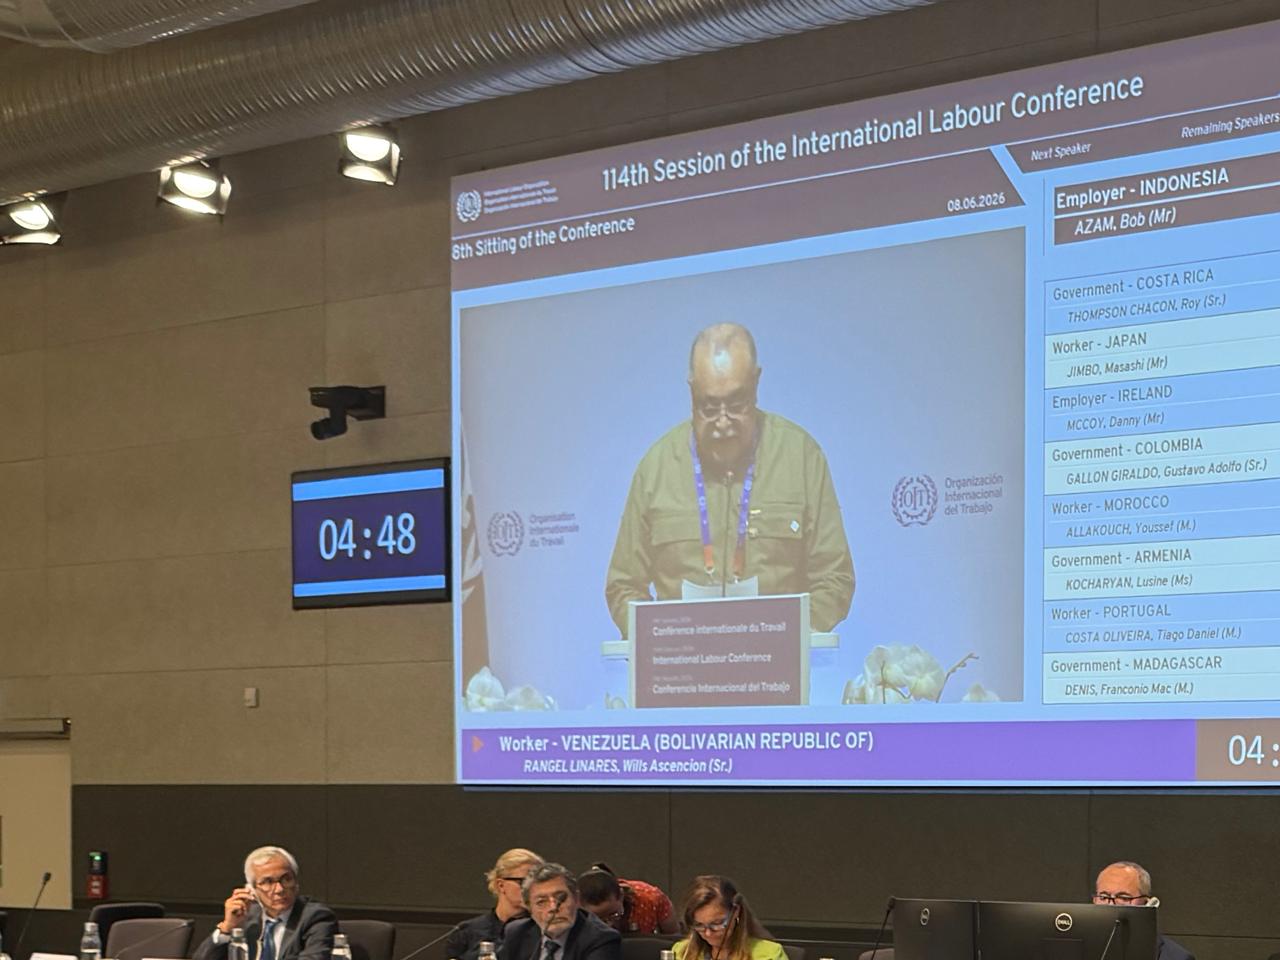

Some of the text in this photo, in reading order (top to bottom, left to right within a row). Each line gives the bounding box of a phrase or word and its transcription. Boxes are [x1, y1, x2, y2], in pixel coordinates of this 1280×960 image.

[602, 70, 1144, 193] 114th Session of the International Labour Conference
[1180, 107, 1280, 141] Remaining Speakers
[1030, 138, 1092, 164] Next Speaker
[1056, 166, 1230, 213] Employer INDONESIA
[946, 190, 1006, 214] 08.06.2026
[1073, 204, 1177, 238] AZAM, Bob (Mr)
[474, 232, 517, 261] Sitting
[518, 229, 534, 250] of
[534, 225, 556, 248] the
[558, 212, 636, 244] Conference
[1052, 267, 1214, 302] Government COSTA RICA
[1066, 292, 1227, 324] THOMPSON CHACON, Roy (Sr.)
[1051, 330, 1148, 356] Worker JAPAN
[1066, 355, 1168, 380] JIMBO, Masashi (Mr)
[1051, 383, 1173, 412] Employer IRELAND
[1065, 410, 1165, 434] MCCOY, Danny (Mr)
[1051, 436, 1204, 463] Government COLOMBIA
[944, 471, 1003, 490] Organización
[1065, 457, 1268, 486] GALLON GIRALDO, Gustavo Adolfo (Sr.)
[944, 486, 1003, 502] Internacional
[1051, 493, 1169, 516] Worker MOROCCO
[944, 501, 993, 516] del Trabajo
[319, 512, 416, 560] 04:48
[1065, 518, 1197, 540] ALLAKOUCH, Youssef (M.)
[1051, 547, 1192, 569] Government ARMENIA
[1065, 573, 1193, 593] KOCHARYAN, Lusine (Ms)
[1050, 602, 1172, 621] Worker PORTUGAL
[1064, 625, 1242, 644] COSTA OLIVEIRA, Tiago Daniel (M.)
[1050, 655, 1223, 673] Government MADAGASCAR
[1064, 681, 1195, 698] DENIS, Franconio Mac (M.)
[499, 730, 874, 752] Worker VENEZUELA (BOLIVARIAN REPUBLIC OF)
[522, 757, 733, 776] RANGEL LINARES, Wills Ascencion (Sr.)
